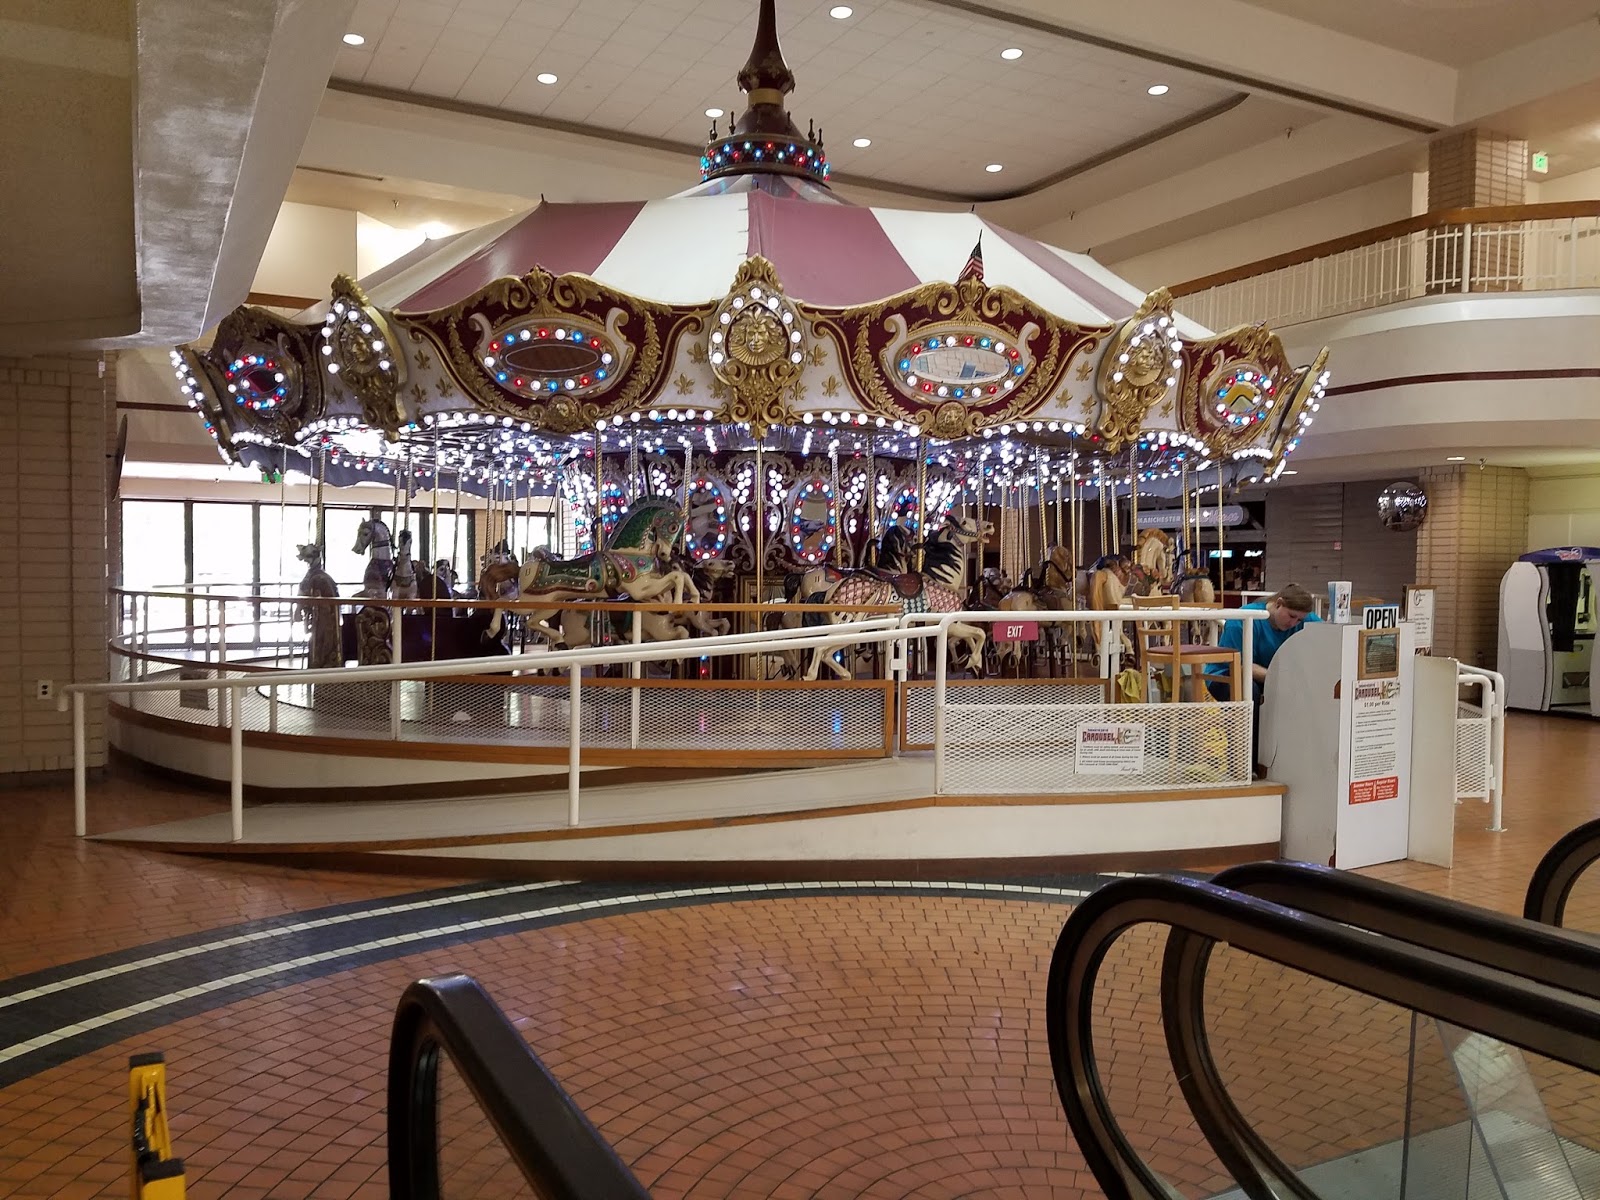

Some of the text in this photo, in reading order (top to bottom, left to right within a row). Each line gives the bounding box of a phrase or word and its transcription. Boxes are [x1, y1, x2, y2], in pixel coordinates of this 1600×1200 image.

[1137, 516, 1181, 524] MANCHESTER
[1366, 608, 1397, 629] OPEN
[1007, 625, 1024, 638] EXIT
[1082, 731, 1115, 742] CAROUSEL
